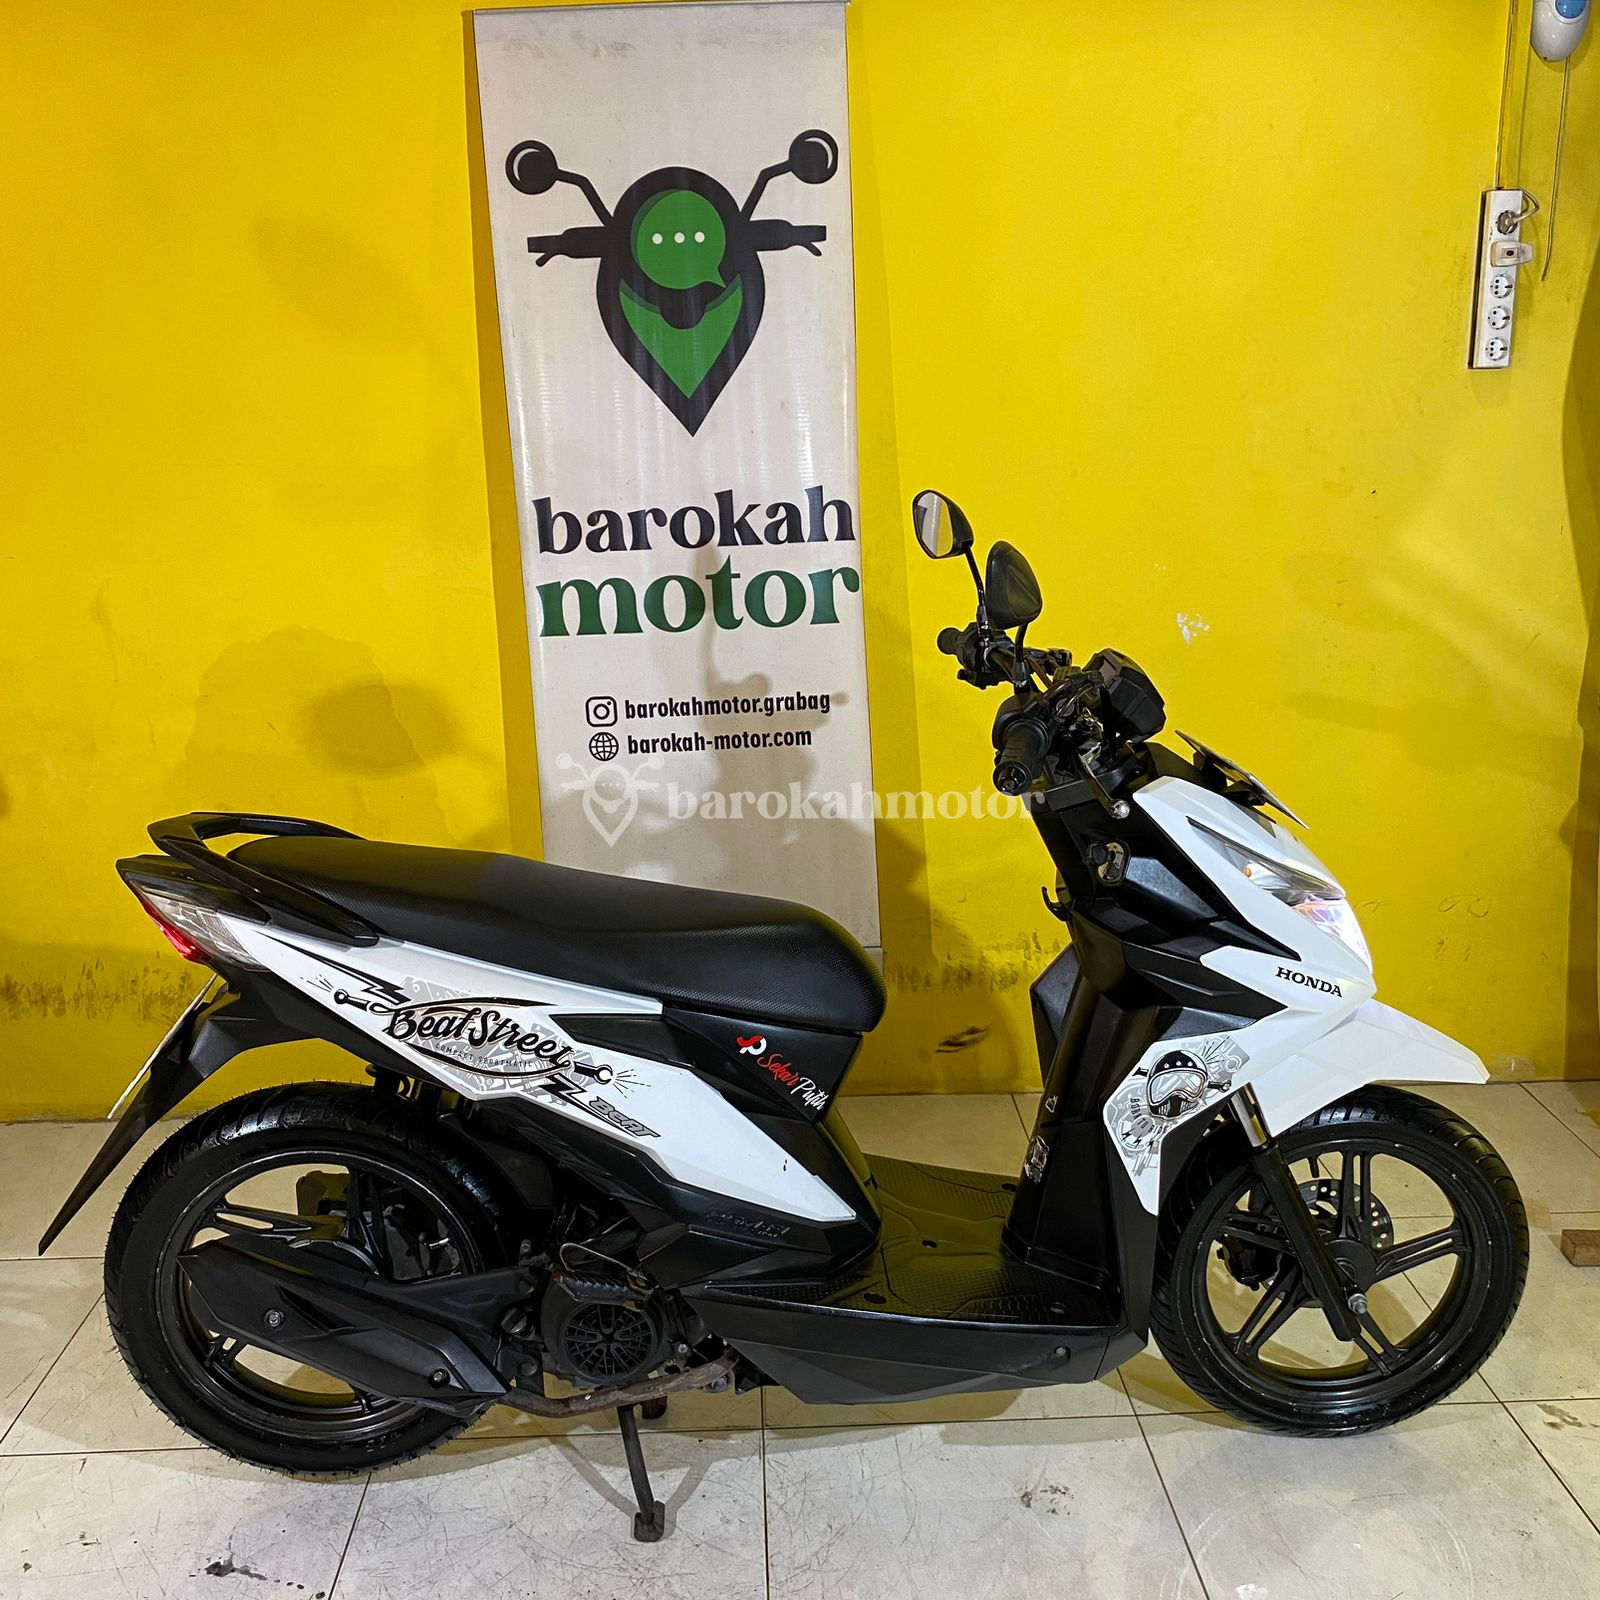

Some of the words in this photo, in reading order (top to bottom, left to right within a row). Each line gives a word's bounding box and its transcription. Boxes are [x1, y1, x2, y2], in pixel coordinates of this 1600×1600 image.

[532, 484, 855, 555] barokah
[536, 554, 860, 637] motor
[624, 691, 830, 719] barokahmotor.grabag
[627, 730, 812, 754] barokah-motor.com
[1276, 966, 1343, 998] HONDA
[435, 1043, 474, 1061] COMPACT
[467, 1009, 575, 1070] Street
[478, 1056, 533, 1068] SPORTMATIC
[1130, 1098, 1142, 1119] BORN
[1137, 1117, 1149, 1129] TO
